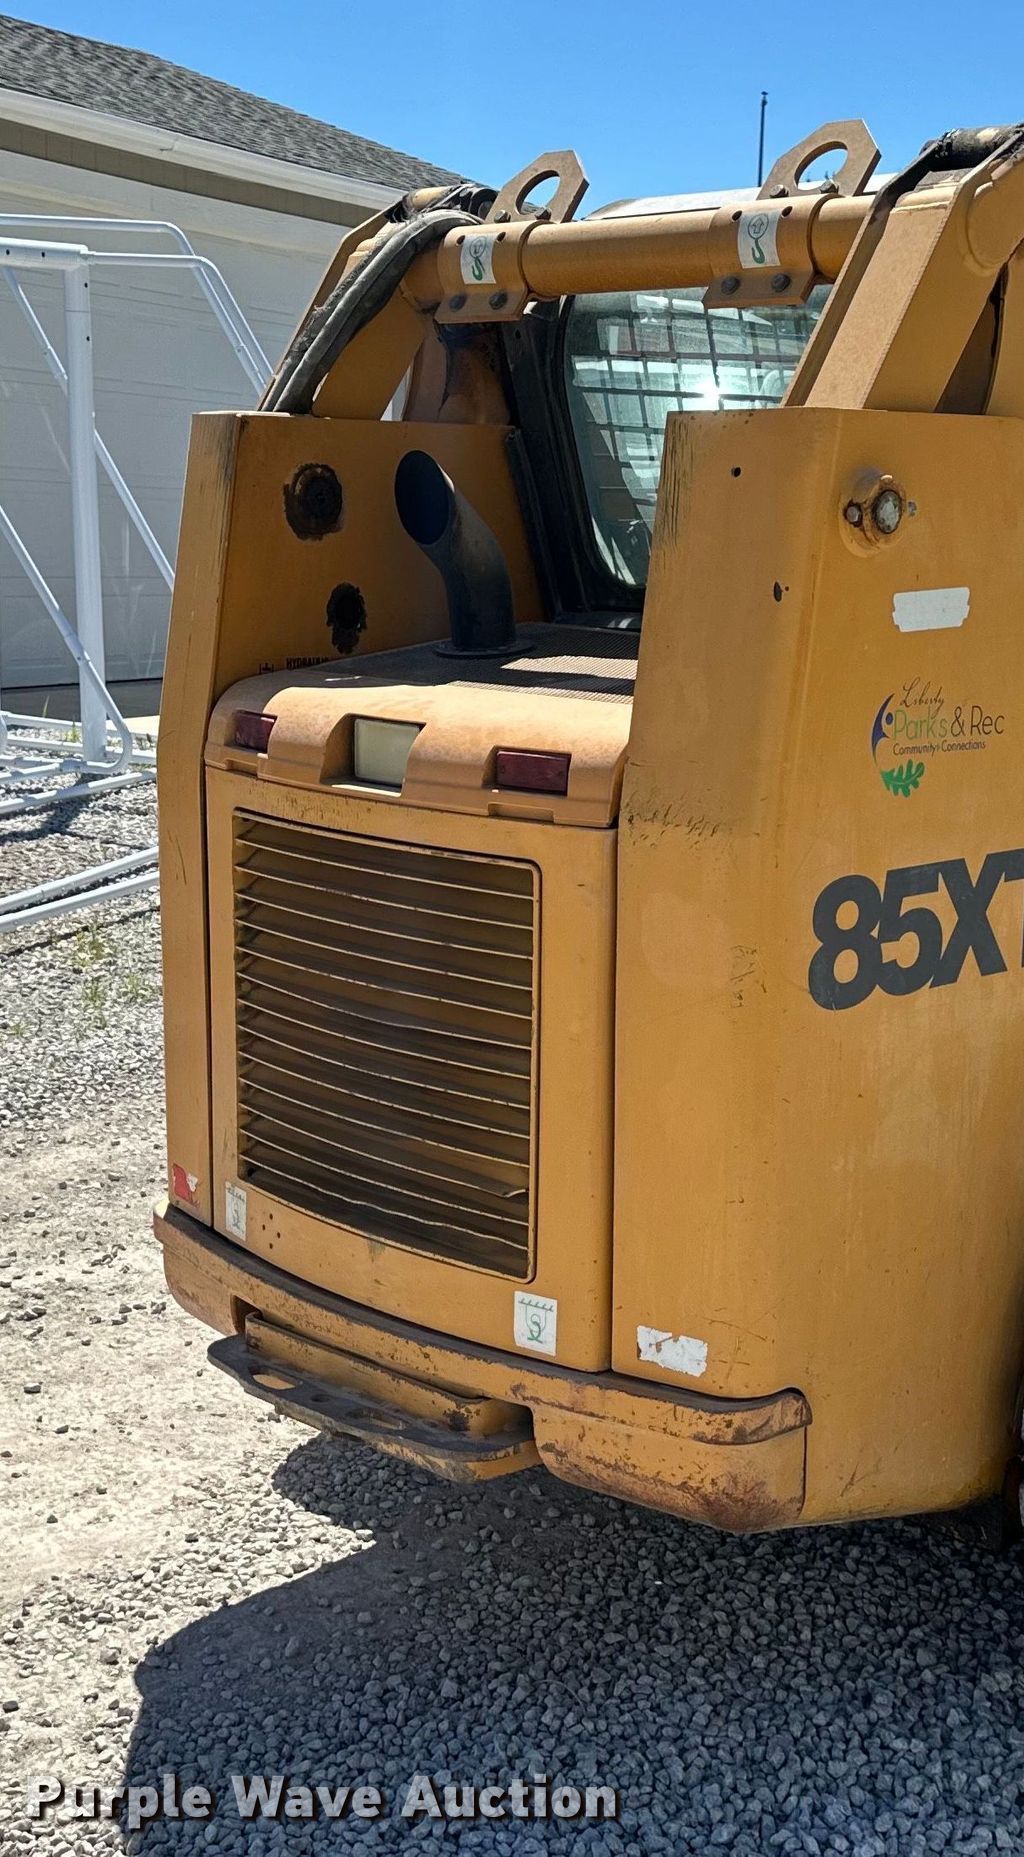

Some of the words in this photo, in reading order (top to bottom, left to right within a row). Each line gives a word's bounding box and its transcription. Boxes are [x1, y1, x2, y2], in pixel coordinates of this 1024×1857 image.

[286, 656, 329, 672] HYDRAU
[900, 676, 945, 720] Liberty
[893, 709, 948, 741] Parks
[950, 706, 965, 737] &
[970, 705, 1006, 737] Rec
[941, 739, 987, 753] Connections
